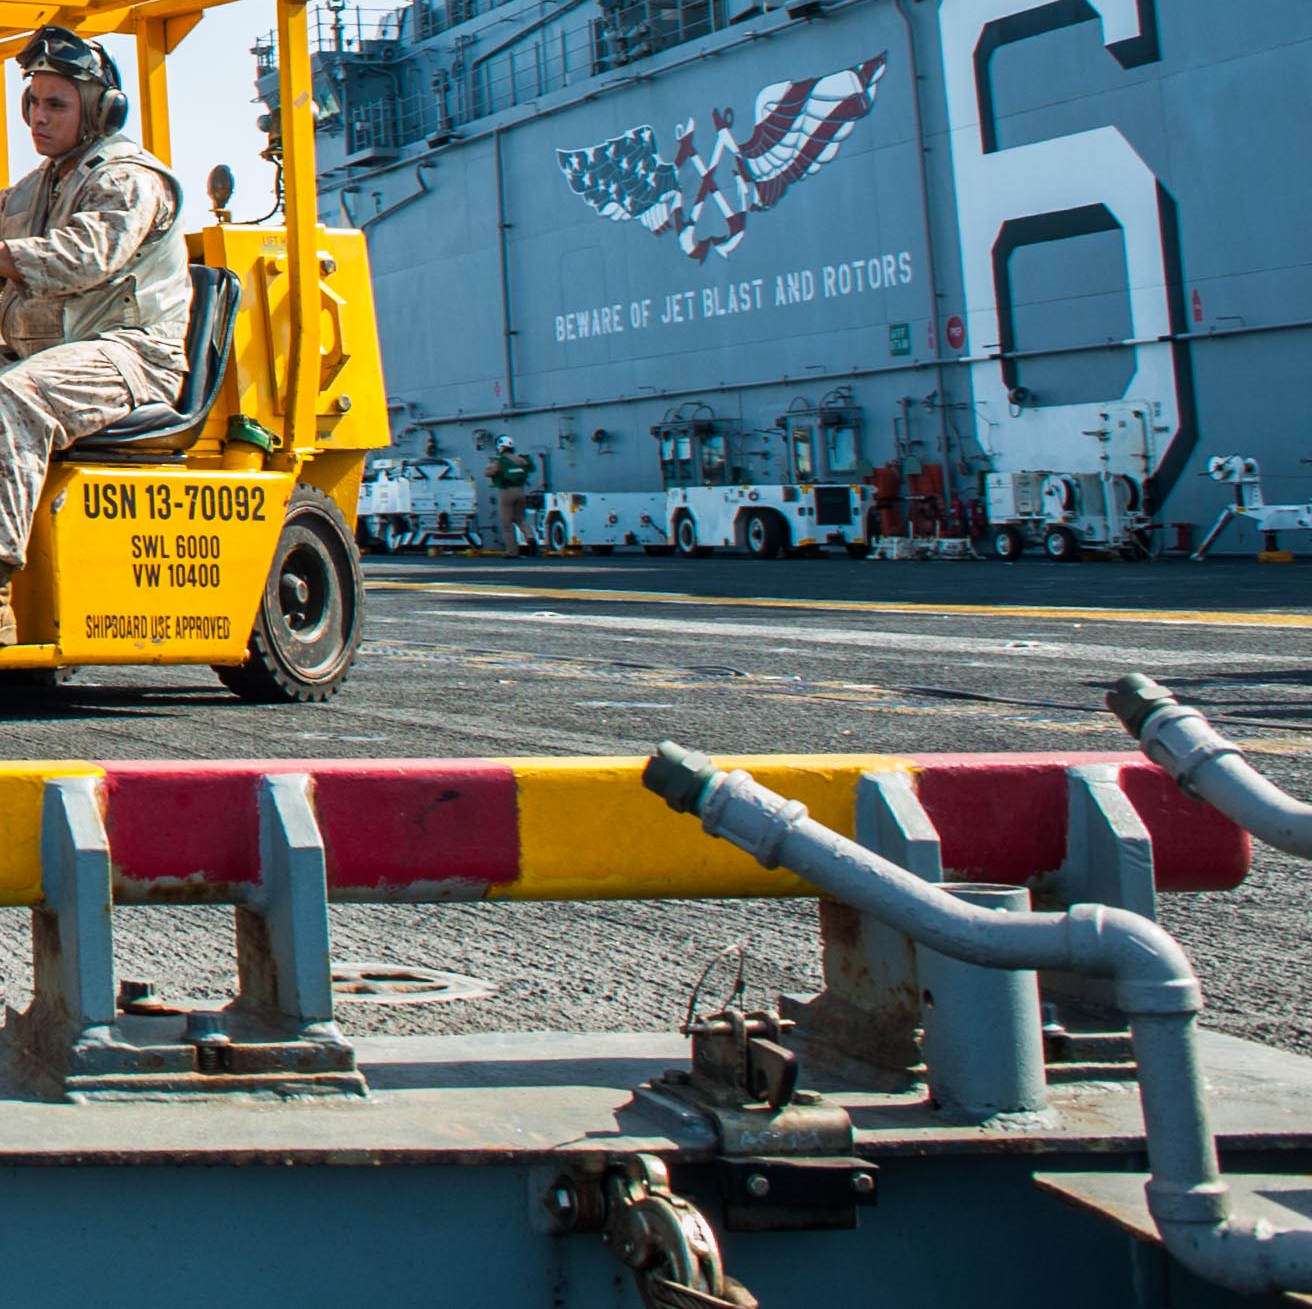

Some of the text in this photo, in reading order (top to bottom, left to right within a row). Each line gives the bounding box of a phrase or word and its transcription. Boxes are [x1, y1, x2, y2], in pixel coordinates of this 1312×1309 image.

[554, 251, 914, 342] BEWARE OF JET BLAST AND ROTORS
[83, 483, 265, 521] USN 13-70092
[131, 535, 220, 559] SWL 6000
[133, 563, 220, 588] VW 10400
[85, 614, 231, 640] SHIPBOARD USE APPROVED
